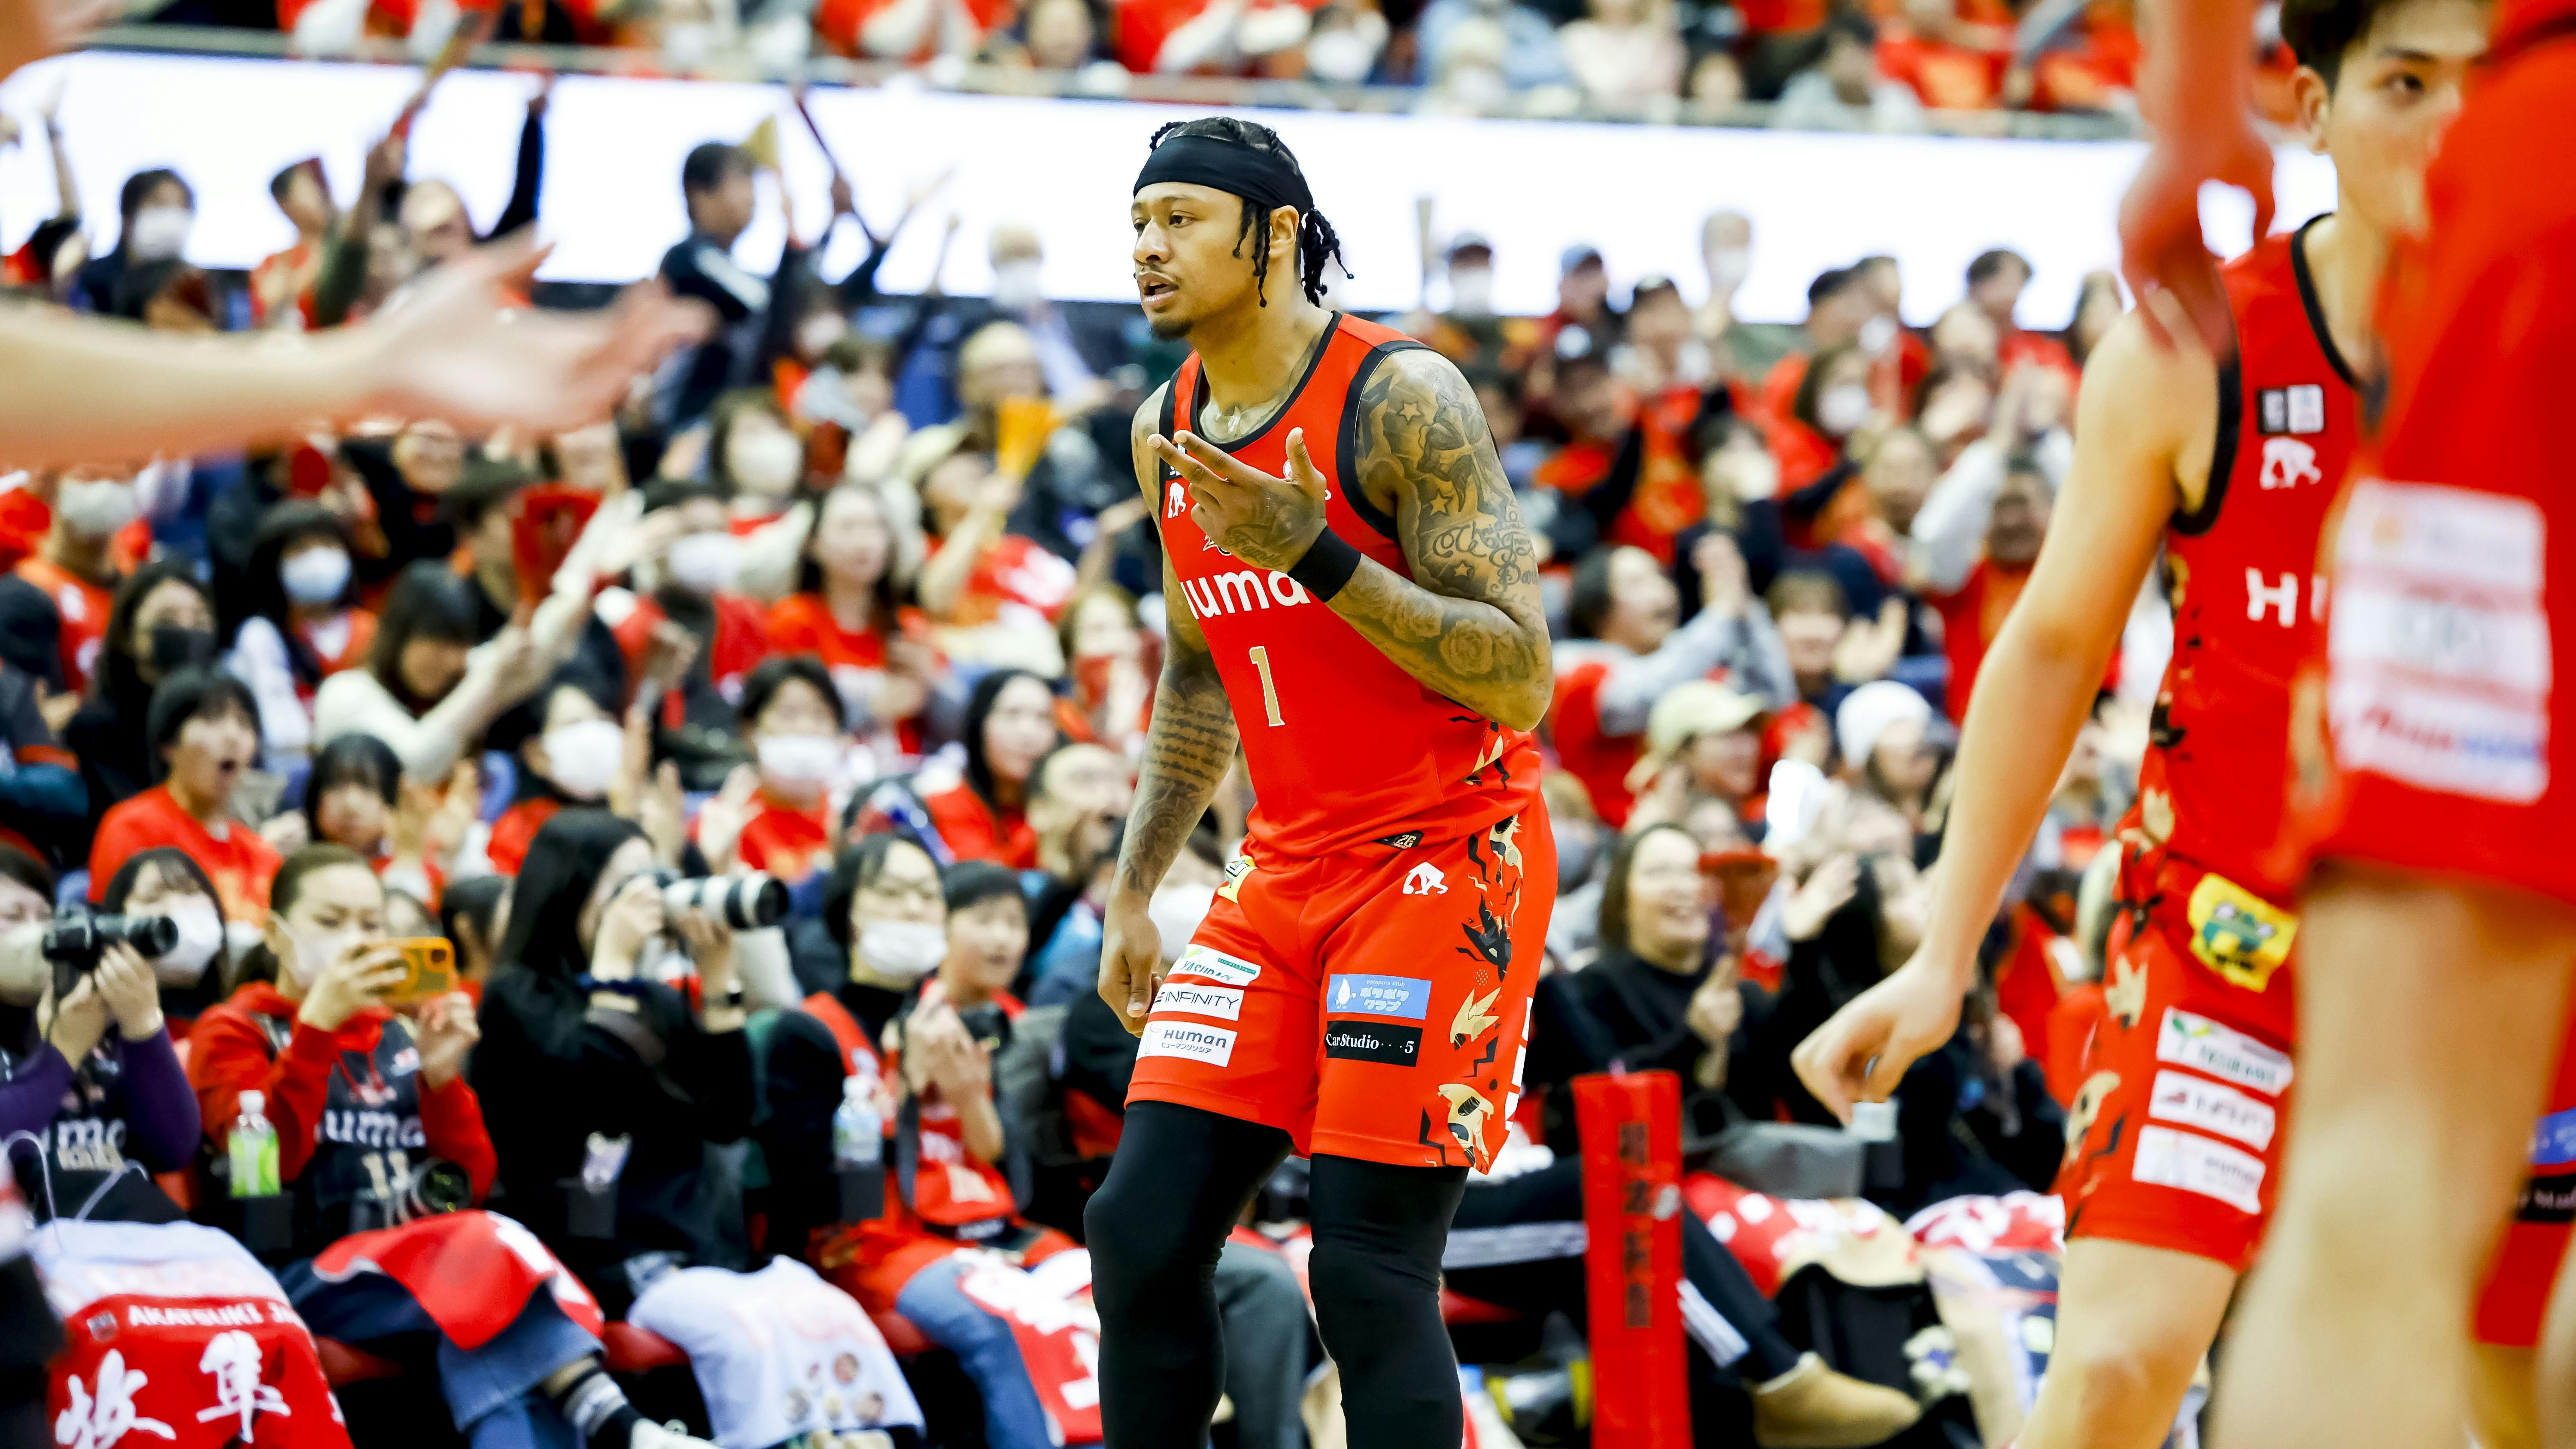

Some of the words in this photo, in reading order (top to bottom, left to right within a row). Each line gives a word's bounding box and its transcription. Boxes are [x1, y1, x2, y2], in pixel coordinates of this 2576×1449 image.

[1180, 570, 1311, 620] uma
[1249, 645, 1285, 727] 1
[1161, 1042, 1212, 1054] ヒューマンリソシア
[1164, 1030, 1227, 1048] Human
